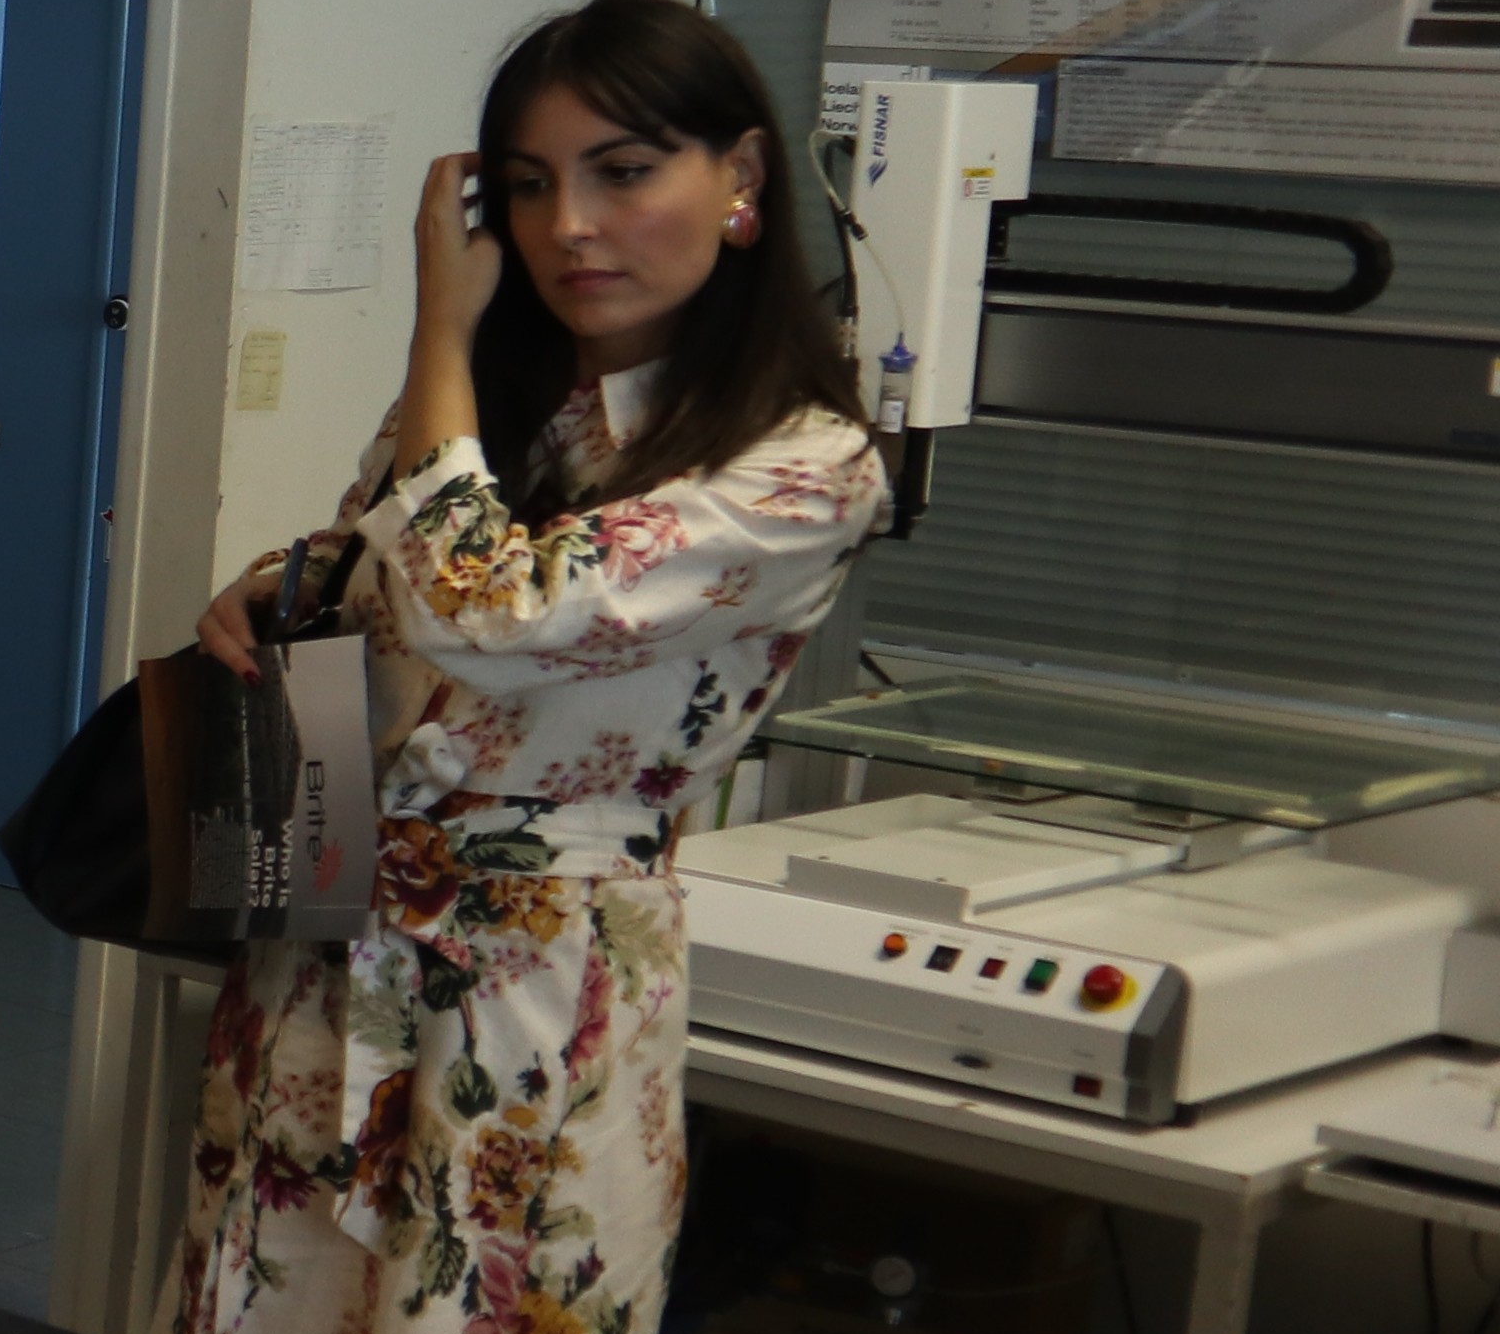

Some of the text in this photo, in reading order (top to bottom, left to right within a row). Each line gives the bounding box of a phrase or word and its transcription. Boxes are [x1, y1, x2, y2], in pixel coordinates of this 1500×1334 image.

[872, 93, 892, 158] FISNAR
[248, 829, 264, 908] Solar?
[261, 846, 277, 908] Brite
[280, 819, 295, 879] Who
